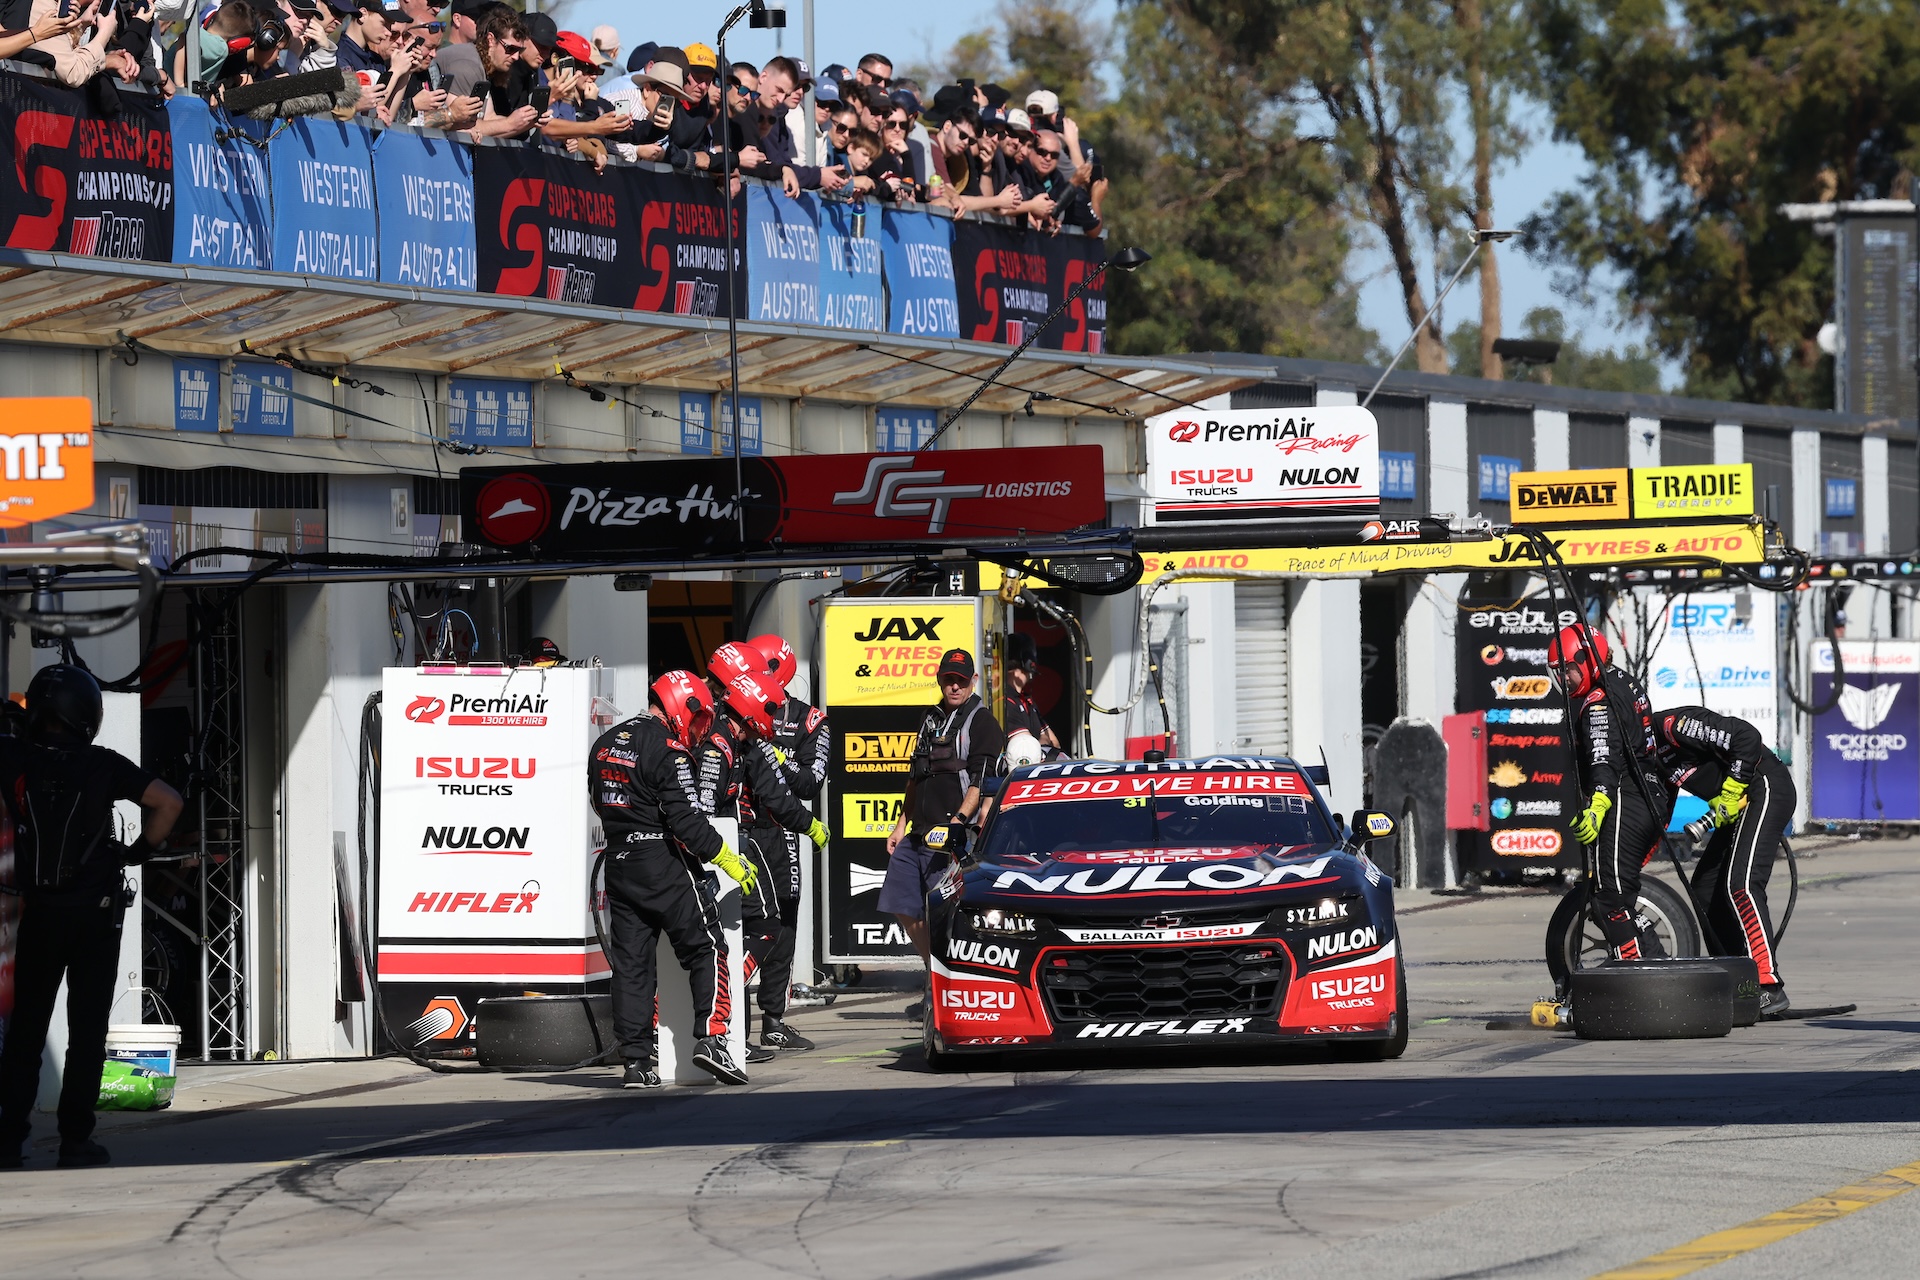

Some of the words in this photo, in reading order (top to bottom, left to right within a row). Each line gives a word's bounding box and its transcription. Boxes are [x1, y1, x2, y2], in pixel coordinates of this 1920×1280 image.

[189, 143, 266, 198] WESTERN
[298, 160, 371, 210] WESTERN
[548, 182, 616, 228] SUPERCARS
[675, 202, 739, 239] SUPERCAS
[294, 230, 376, 278] AUSTRALIA
[548, 226, 617, 263] CHAMPIONSHIP
[761, 282, 818, 322] AUSTRAL
[1204, 417, 1315, 442] PremiAir
[1275, 434, 1370, 455] Racing
[1171, 468, 1253, 485] ISUZU
[1279, 467, 1360, 486] NULON
[1647, 473, 1742, 498] TRADIE
[984, 481, 1071, 498] LOGISTICS
[1187, 487, 1238, 496] TRUCKS
[392, 494, 407, 528] 18
[560, 486, 674, 530] Pizza
[675, 484, 762, 524] Hut
[1386, 520, 1420, 532] AIR
[144, 528, 169, 556] RTH
[1489, 539, 1566, 564] JAX
[1568, 540, 1652, 557] TYRES
[1654, 543, 1668, 553] &
[1673, 536, 1742, 552] AUTO
[1163, 562, 1176, 571] &
[1183, 554, 1249, 568] AUTO
[1329, 554, 1345, 567] of
[1348, 549, 1390, 565] Mind
[1395, 544, 1452, 560] Driving
[1671, 604, 1754, 628] BR
[854, 617, 944, 642] JAX
[864, 646, 943, 660] TYRES
[855, 664, 871, 677] &
[874, 664, 940, 677] AUTO
[876, 683, 885, 693] of
[886, 682, 907, 691] Mind
[909, 680, 938, 690] Driving
[1509, 682, 1546, 694] BIC
[450, 694, 548, 713] PremiAir
[1489, 733, 1561, 748] Snap-on
[609, 747, 639, 761] PremiAir
[416, 757, 536, 778] ISUZU
[845, 764, 911, 772] GUARANTEE
[1531, 771, 1563, 785] Army
[438, 784, 513, 795] TRUCKS
[1011, 779, 1120, 799] 1300
[1131, 776, 1195, 792] WE
[1203, 775, 1296, 791] HIRE
[856, 800, 905, 822] TRA
[1123, 797, 1147, 808] 31
[1184, 796, 1264, 808] Golding
[1370, 818, 1391, 829] NAPA
[421, 827, 530, 849] NULON
[928, 832, 946, 842] NAPA
[1497, 835, 1557, 850] CHIKO
[787, 842, 798, 863] WE
[1086, 848, 1232, 860] ISUZU
[993, 857, 1333, 894] NULON
[407, 892, 541, 913] HIFLEX
[1080, 932, 1165, 940] BALLARAT
[1176, 927, 1244, 938] ISUZU
[1308, 925, 1378, 959] NULON
[946, 938, 1020, 969] NULON
[1311, 974, 1385, 1000] ISUZU
[942, 989, 1015, 1009] ISUZU
[1327, 997, 1375, 1010] TRUCKS
[954, 1011, 1001, 1021] TRUCKS
[1076, 1018, 1252, 1038] HIFLEX
